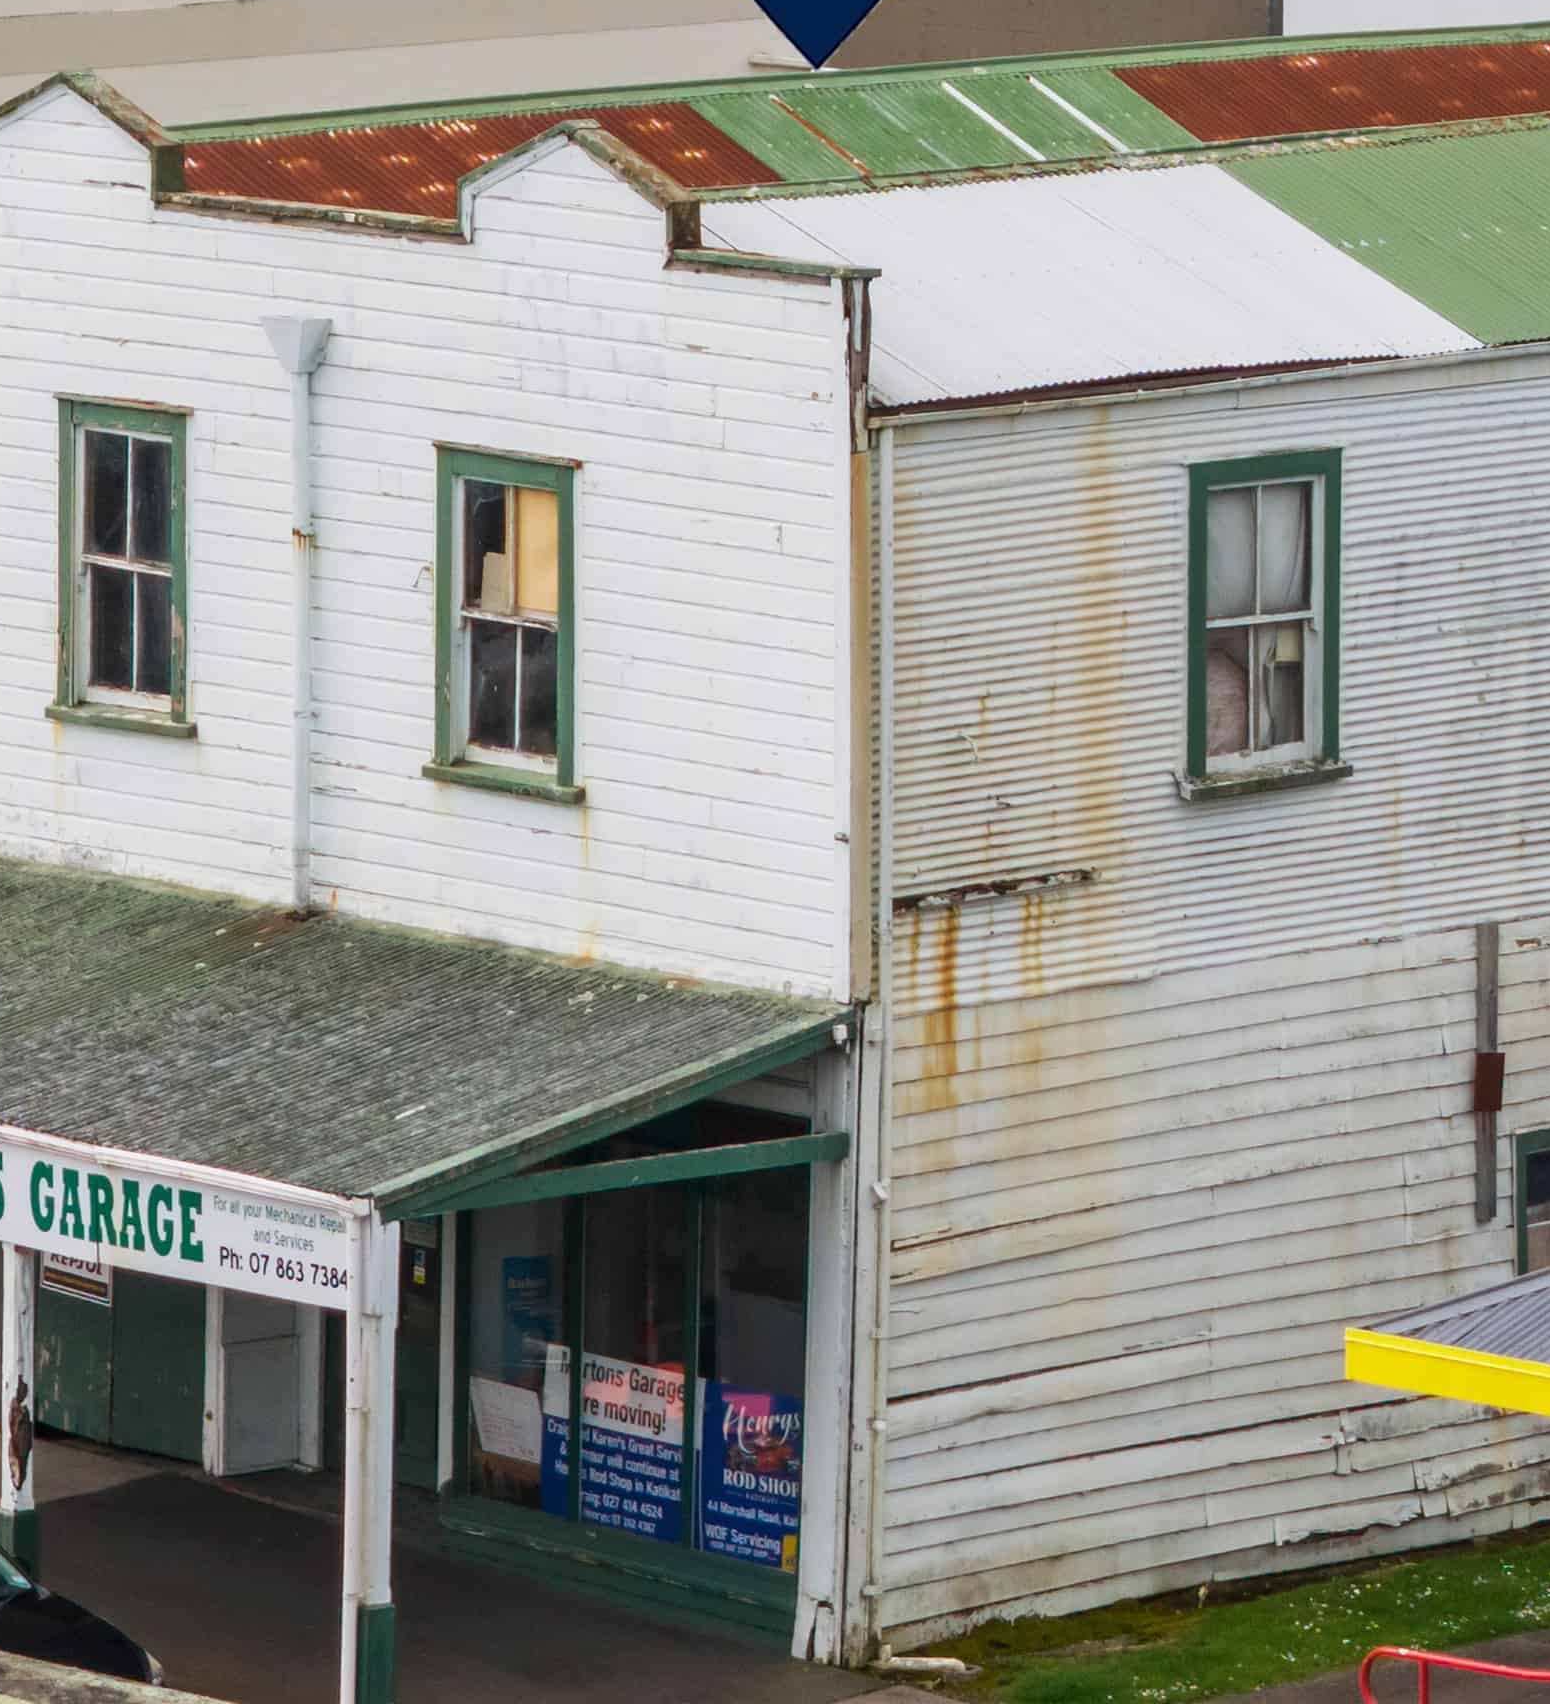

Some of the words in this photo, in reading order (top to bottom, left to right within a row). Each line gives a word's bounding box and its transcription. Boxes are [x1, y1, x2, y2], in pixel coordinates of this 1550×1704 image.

[30, 1161, 205, 1263] GARAGE
[213, 1195, 227, 1211] For
[229, 1200, 240, 1215] all
[242, 1203, 263, 1220] your
[265, 1204, 316, 1228] Mechanical
[253, 1227, 271, 1244] and
[274, 1229, 315, 1252] Services
[219, 1246, 243, 1270] Ph:
[249, 1252, 269, 1276] 07
[275, 1257, 304, 1282] 863
[310, 1263, 347, 1289] 7384
[604, 1400, 667, 1435] moving!
[723, 1468, 756, 1490] ROD
[731, 1529, 781, 1555] Servicing
